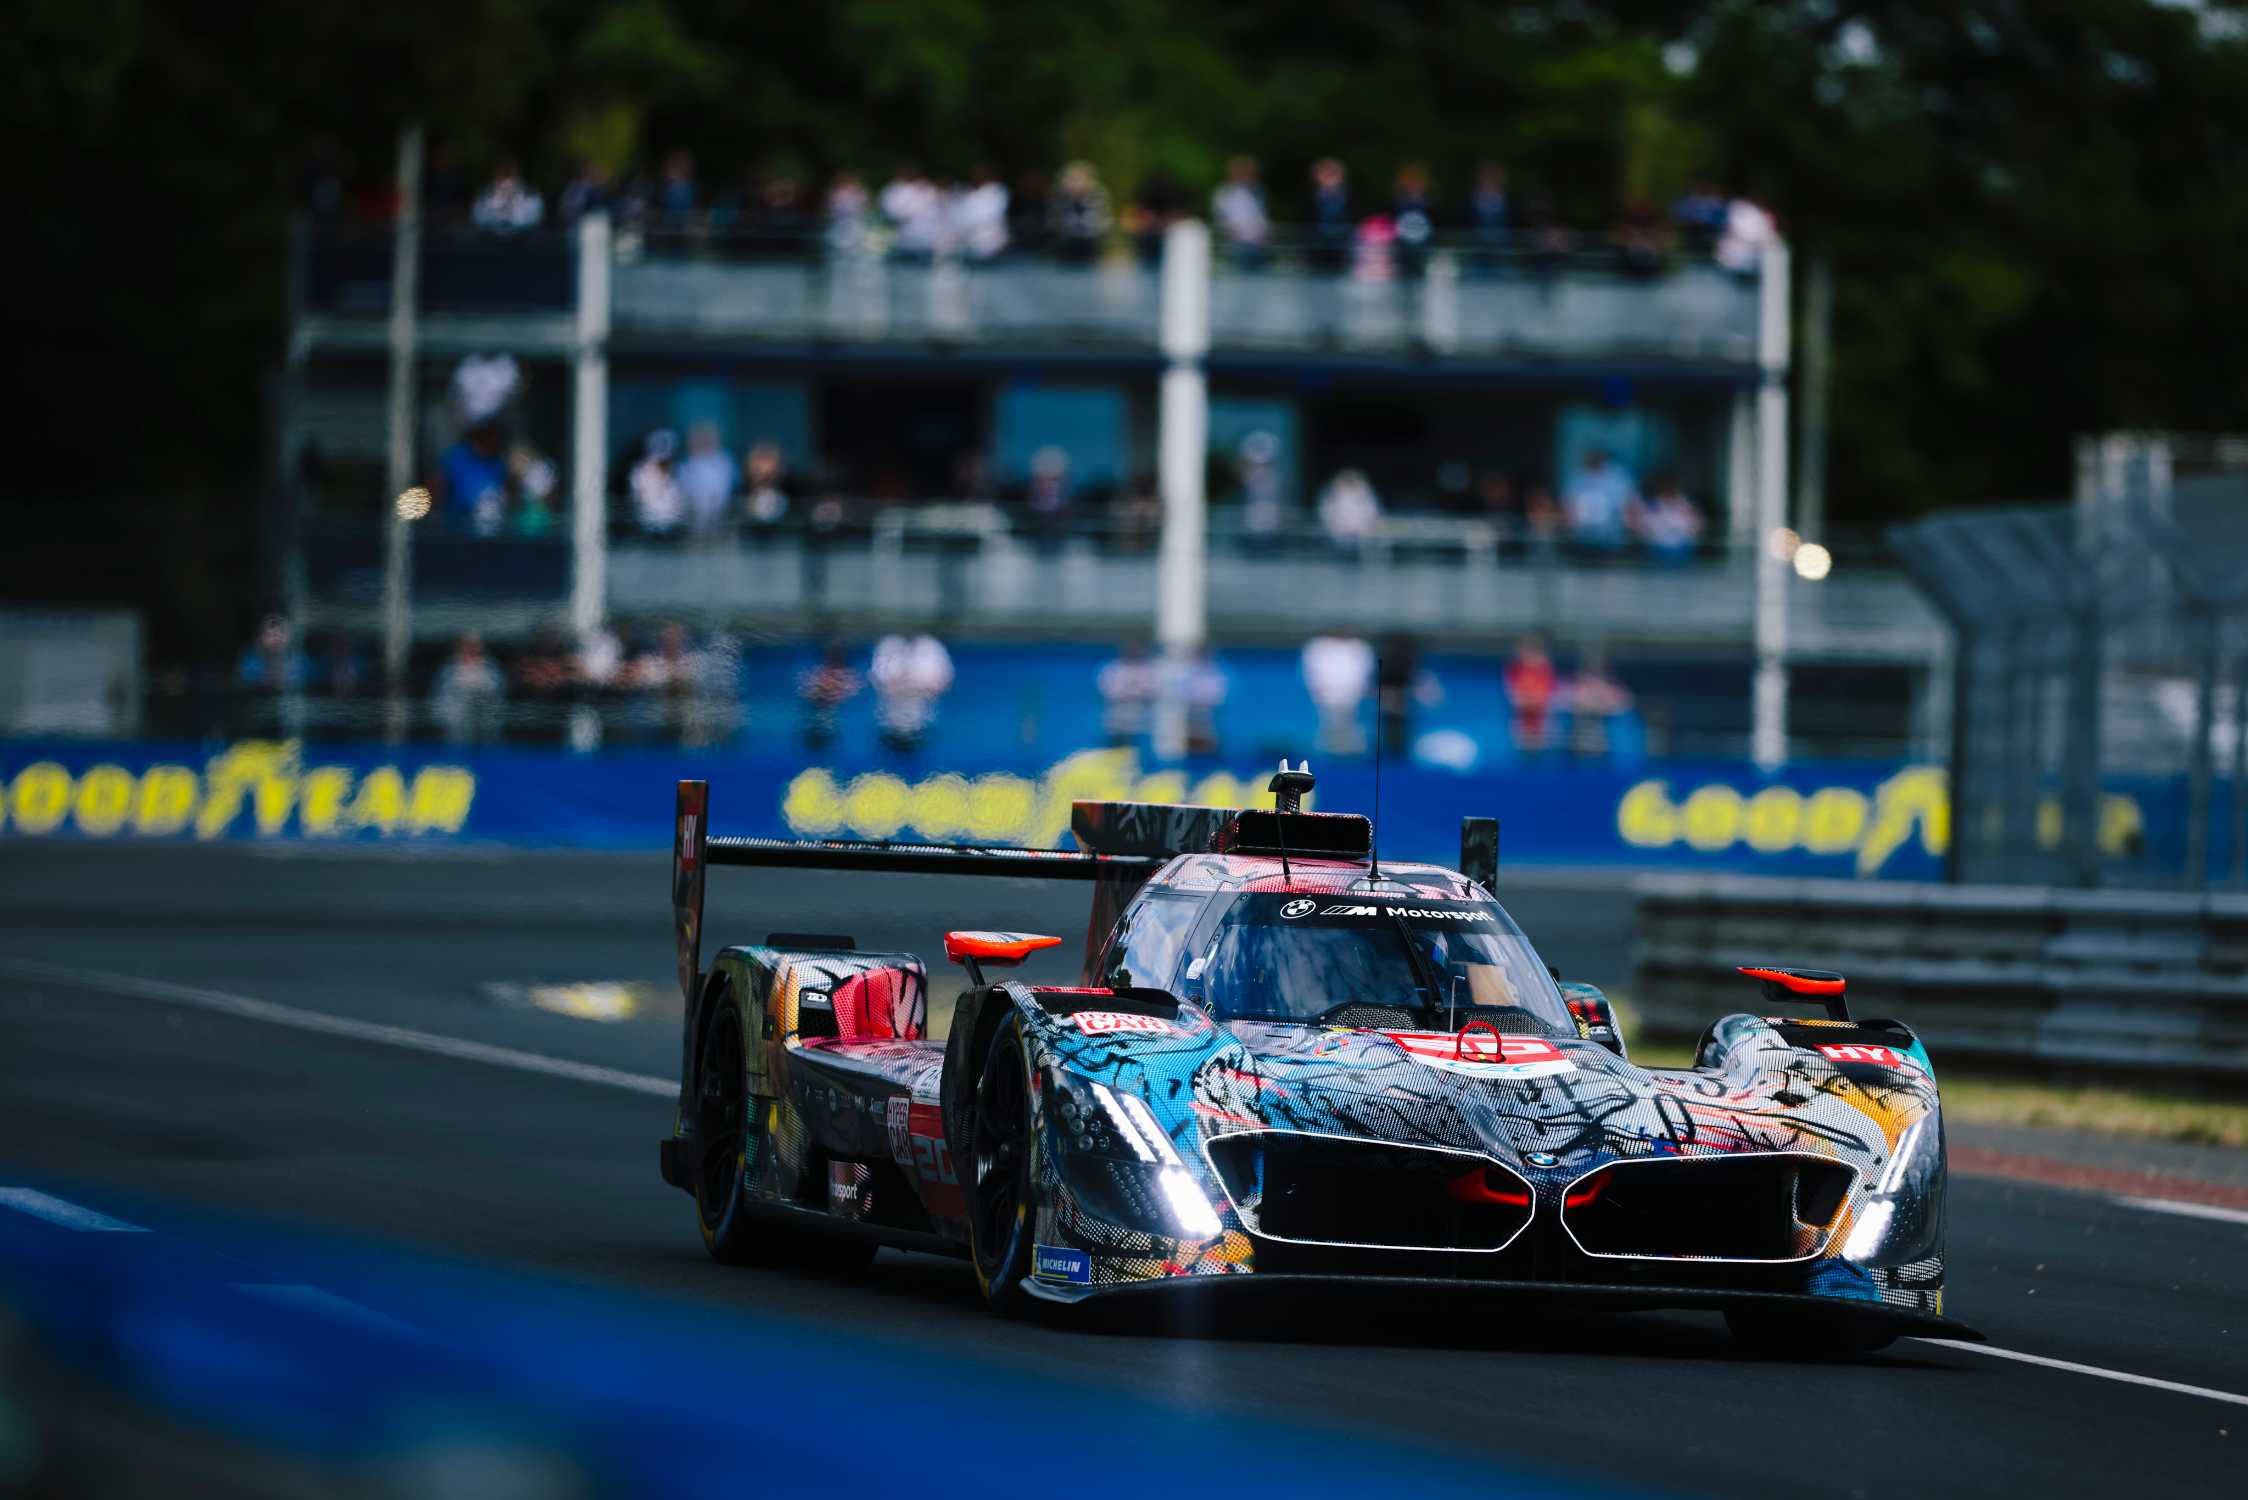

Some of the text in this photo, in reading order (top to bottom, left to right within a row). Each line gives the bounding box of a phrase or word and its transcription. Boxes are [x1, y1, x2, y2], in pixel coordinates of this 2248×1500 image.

[0, 738, 476, 841] OODYEAR
[1618, 765, 1952, 876] GOODY
[1386, 906, 1495, 922] Motorsport
[1085, 1018, 1165, 1031] CAR
[1821, 1046, 1886, 1061] HY
[887, 1101, 909, 1125] HYPER
[1042, 1257, 1081, 1273] MICHELIN
